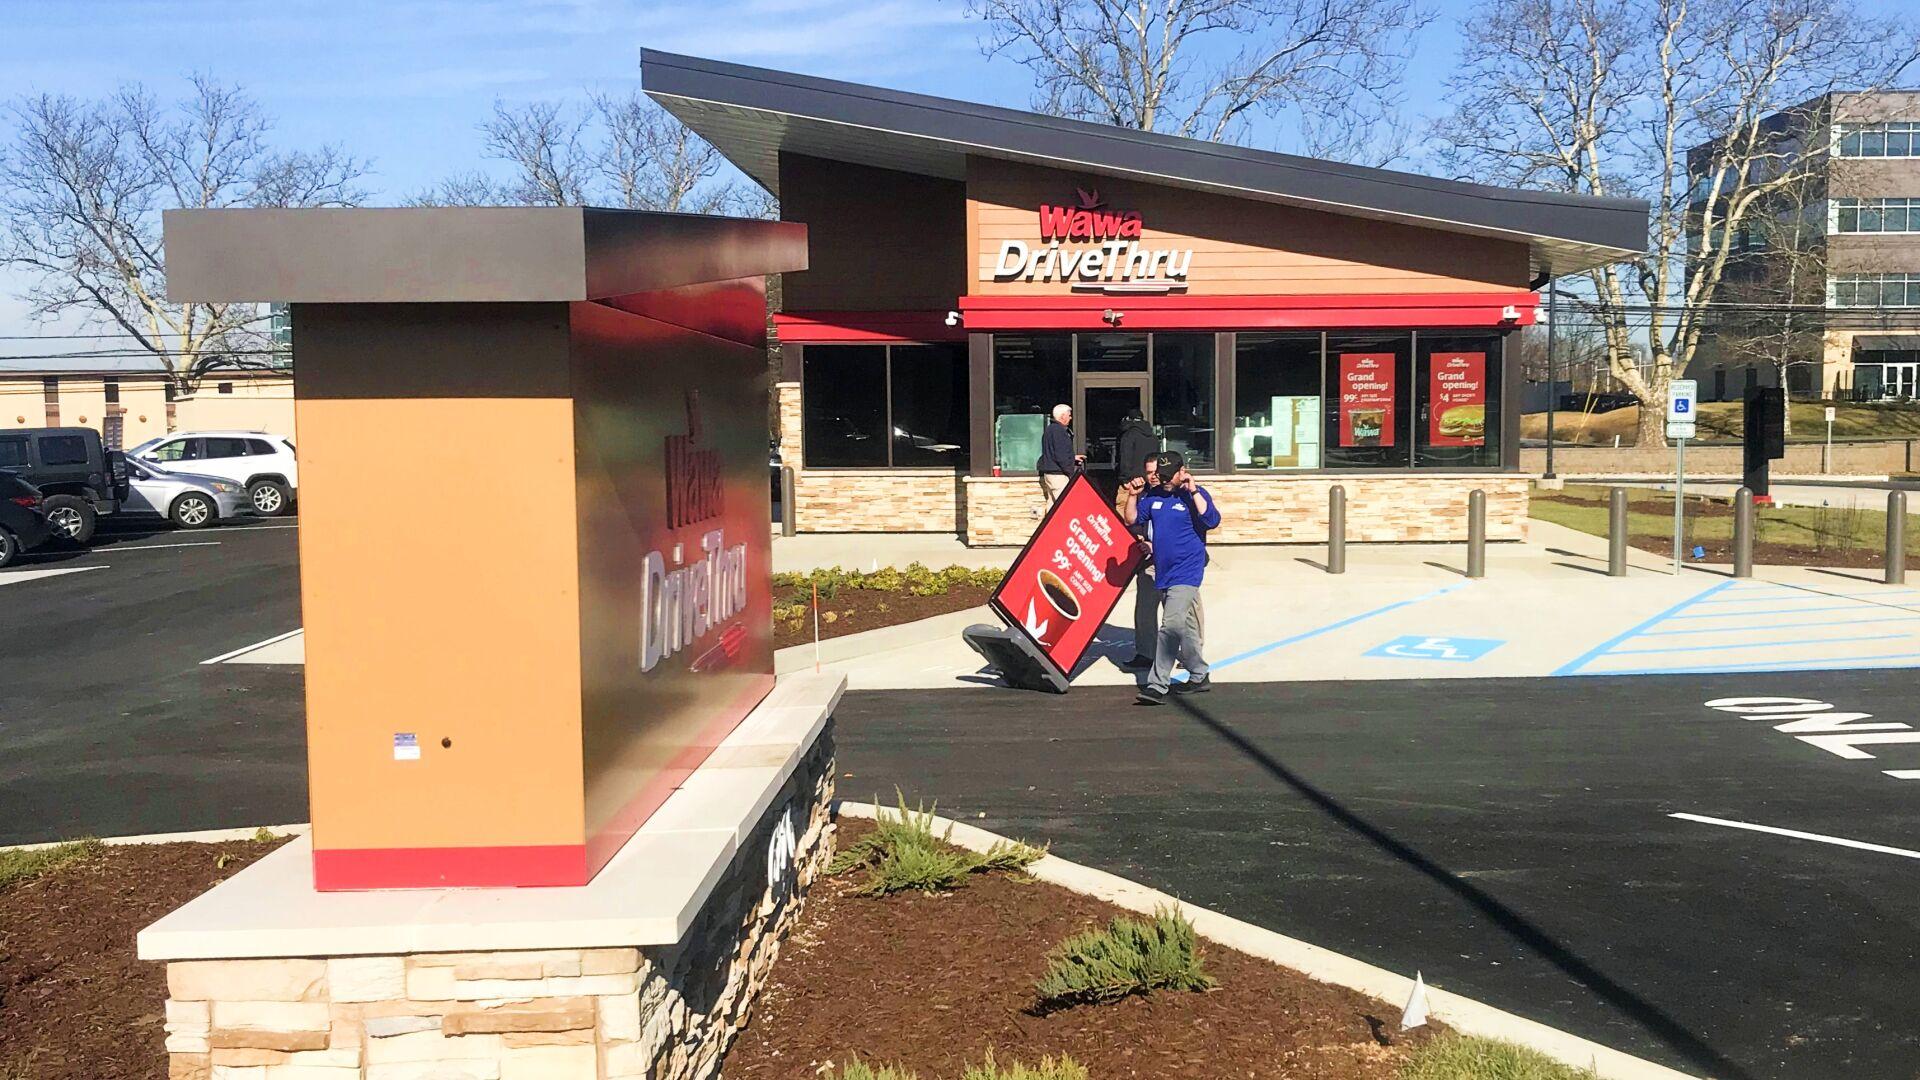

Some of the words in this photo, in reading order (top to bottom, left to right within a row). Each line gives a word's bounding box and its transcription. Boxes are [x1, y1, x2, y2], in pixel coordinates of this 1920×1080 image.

[1039, 204, 1142, 243] Wawa
[993, 239, 1192, 283] DriveThru
[1347, 372, 1374, 381] Grand
[1352, 382, 1388, 391] opening!
[1437, 371, 1465, 380] Grand
[1442, 381, 1478, 390] opening!
[1439, 393, 1449, 402] $4
[1069, 518, 1100, 556] Grand
[1066, 536, 1106, 583] opening!
[641, 528, 748, 673] DriveThru
[1704, 696, 1920, 780] ONL
